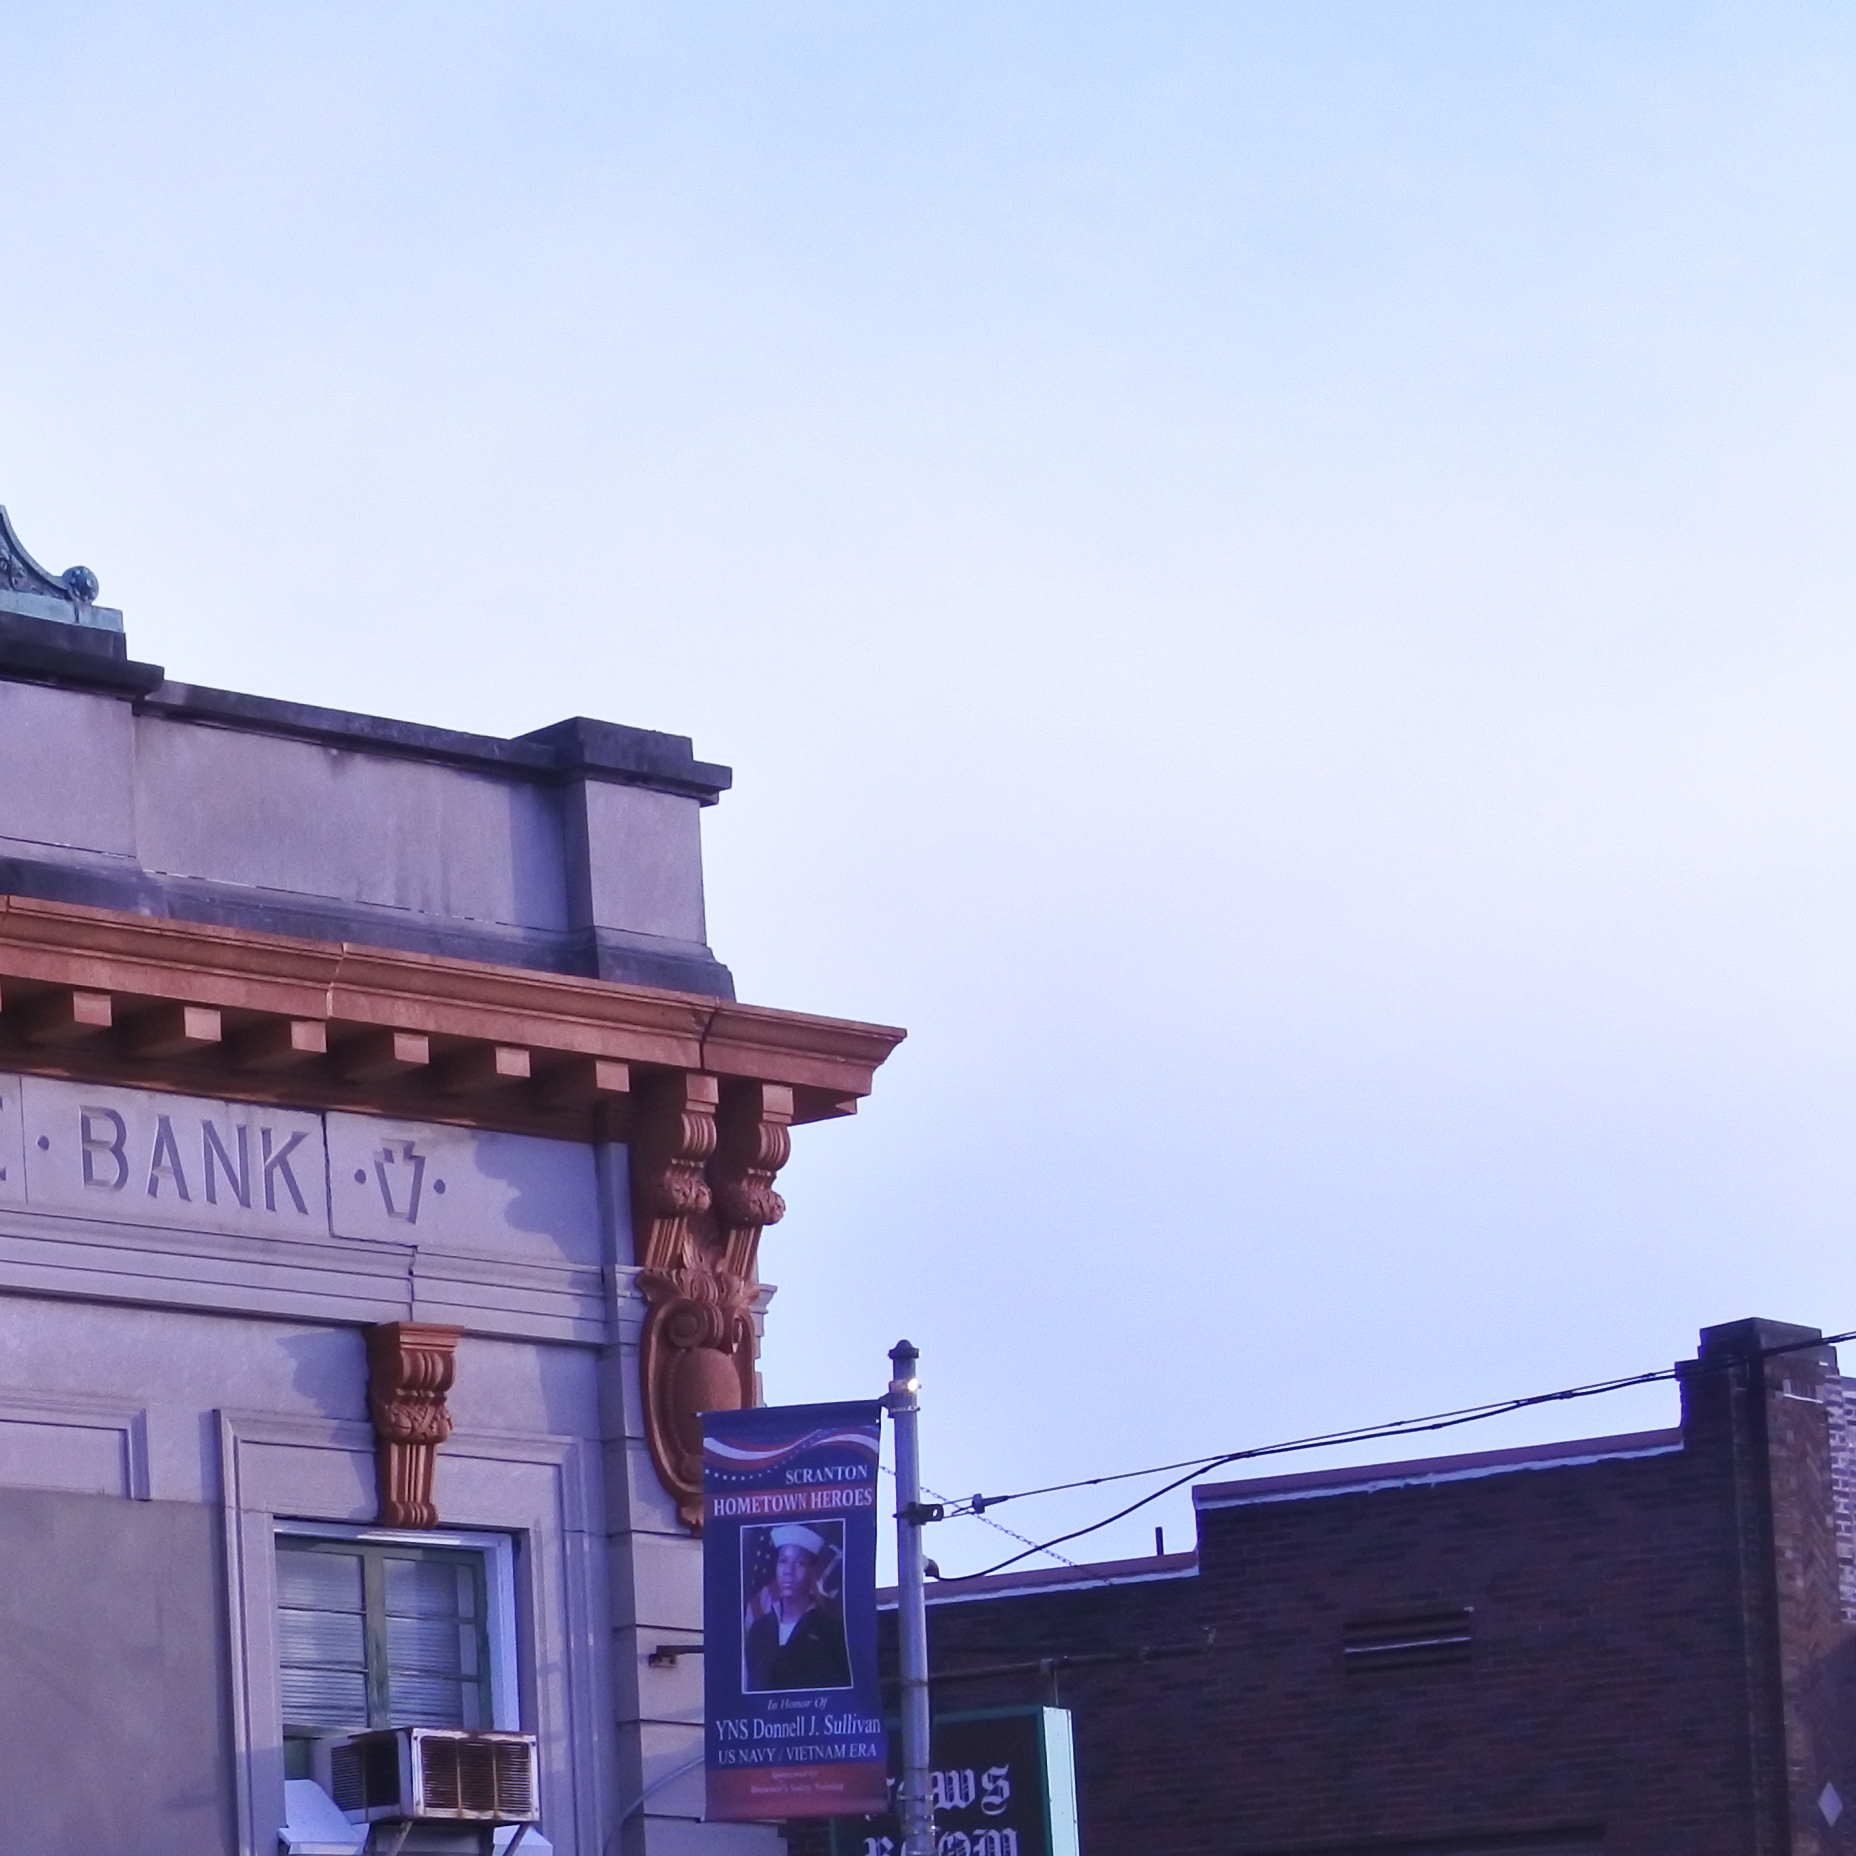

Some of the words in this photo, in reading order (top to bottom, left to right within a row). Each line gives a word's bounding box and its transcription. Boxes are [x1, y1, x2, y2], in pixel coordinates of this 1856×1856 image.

[83, 1105, 311, 1216] BANK
[786, 1465, 868, 1484] SCRANTON
[714, 1493, 807, 1516] HOMETOWN
[811, 1488, 873, 1508] HEROES
[767, 1699, 778, 1710] In
[781, 1698, 811, 1710] Honor
[814, 1696, 828, 1710] Of
[716, 1719, 749, 1740] YNS
[753, 1716, 805, 1739] Donnell
[808, 1716, 820, 1736] J.
[824, 1714, 881, 1736] Sullivan
[718, 1749, 736, 1765] US
[739, 1748, 776, 1763] NAVY
[786, 1744, 846, 1762] VIETNAM
[849, 1743, 877, 1758] ERA
